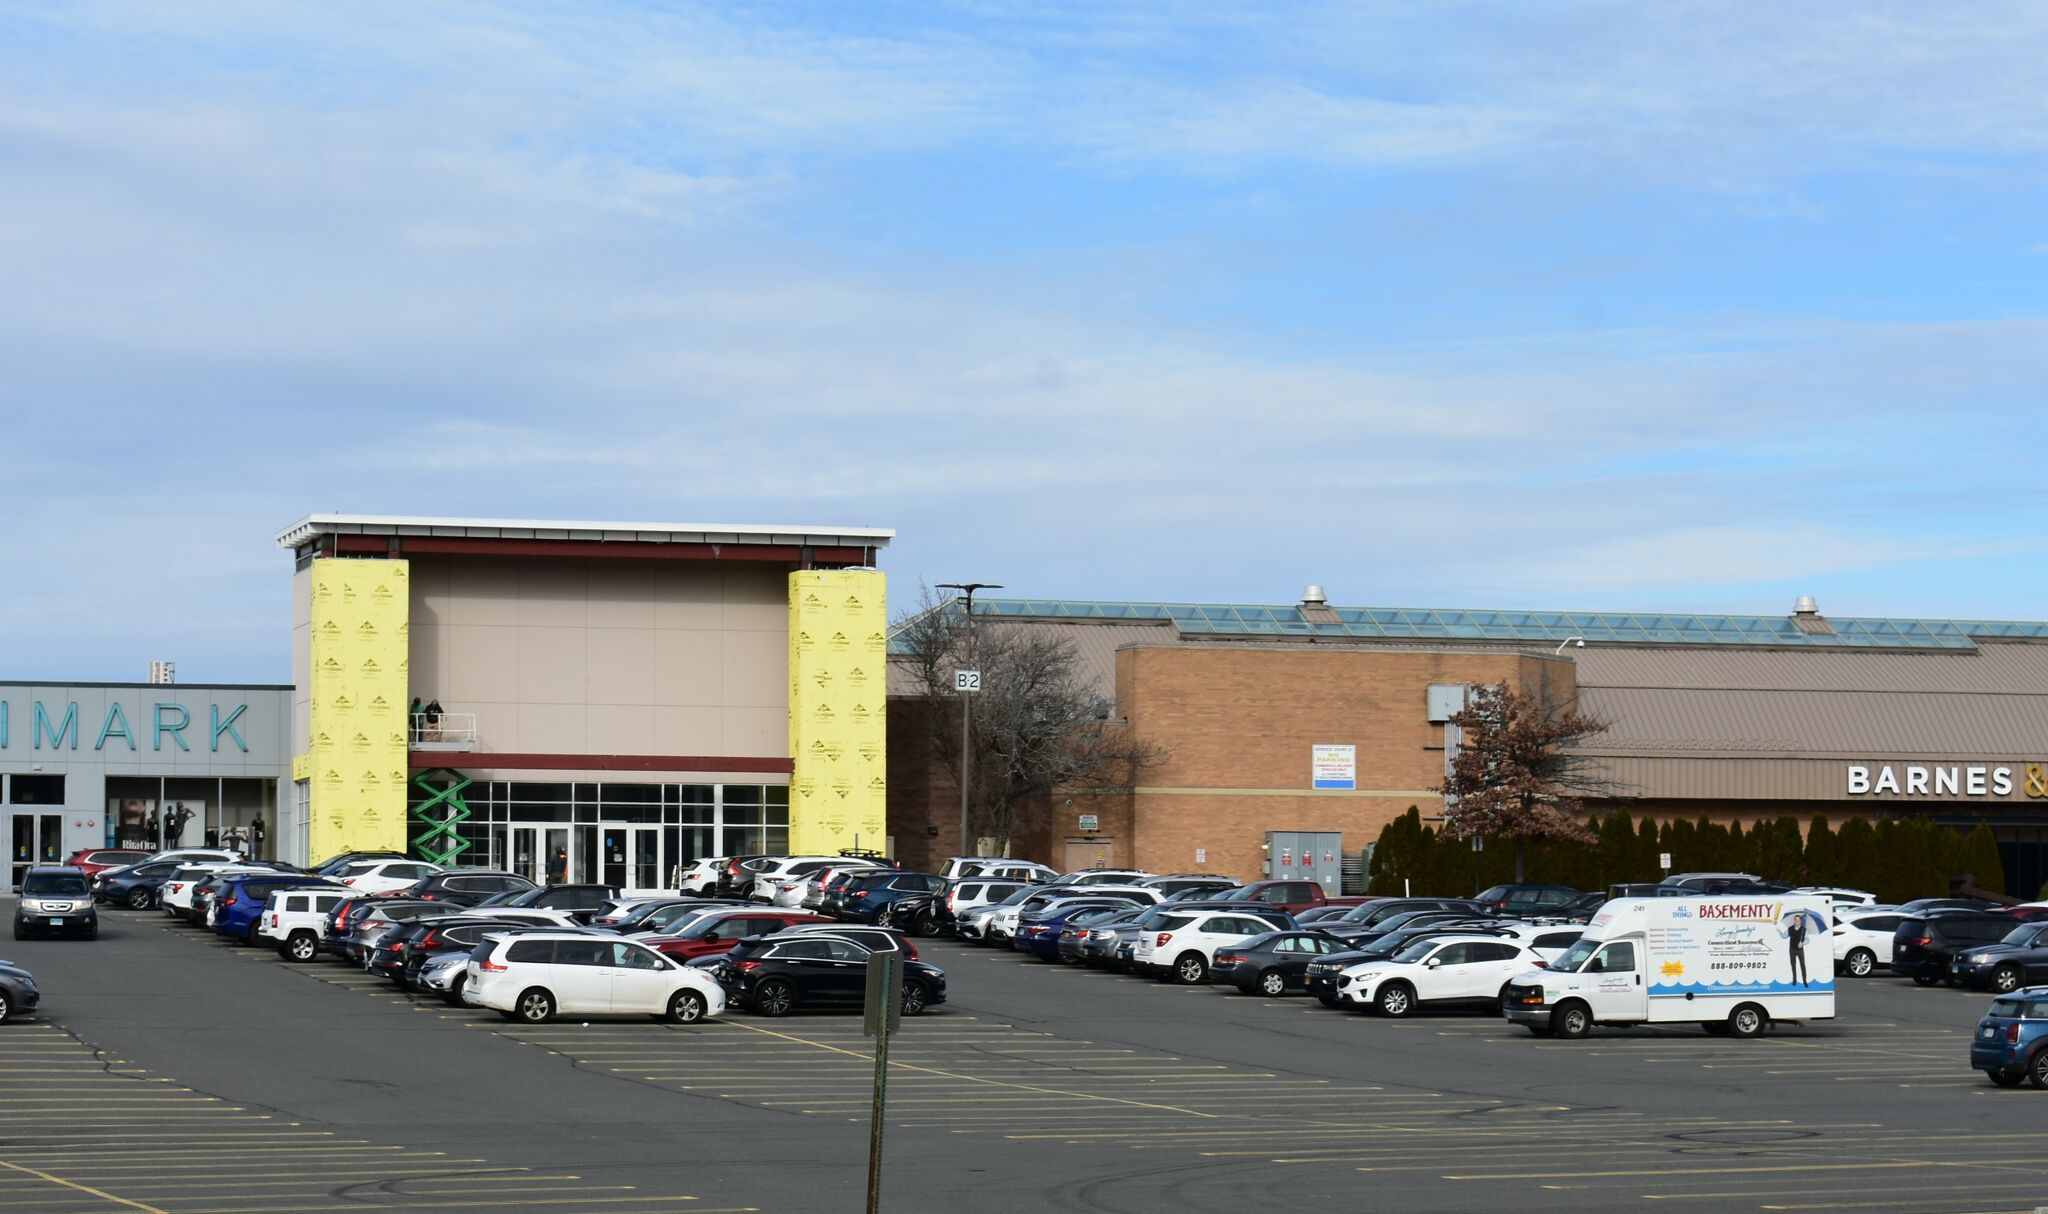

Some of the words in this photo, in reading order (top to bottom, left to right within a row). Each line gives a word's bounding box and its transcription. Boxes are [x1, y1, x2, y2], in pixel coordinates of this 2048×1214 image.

[0, 700, 249, 752] IMARK
[1847, 765, 2013, 796] BARNES
[2024, 764, 2048, 799] &
[1710, 962, 1767, 970] 888-809-9802
